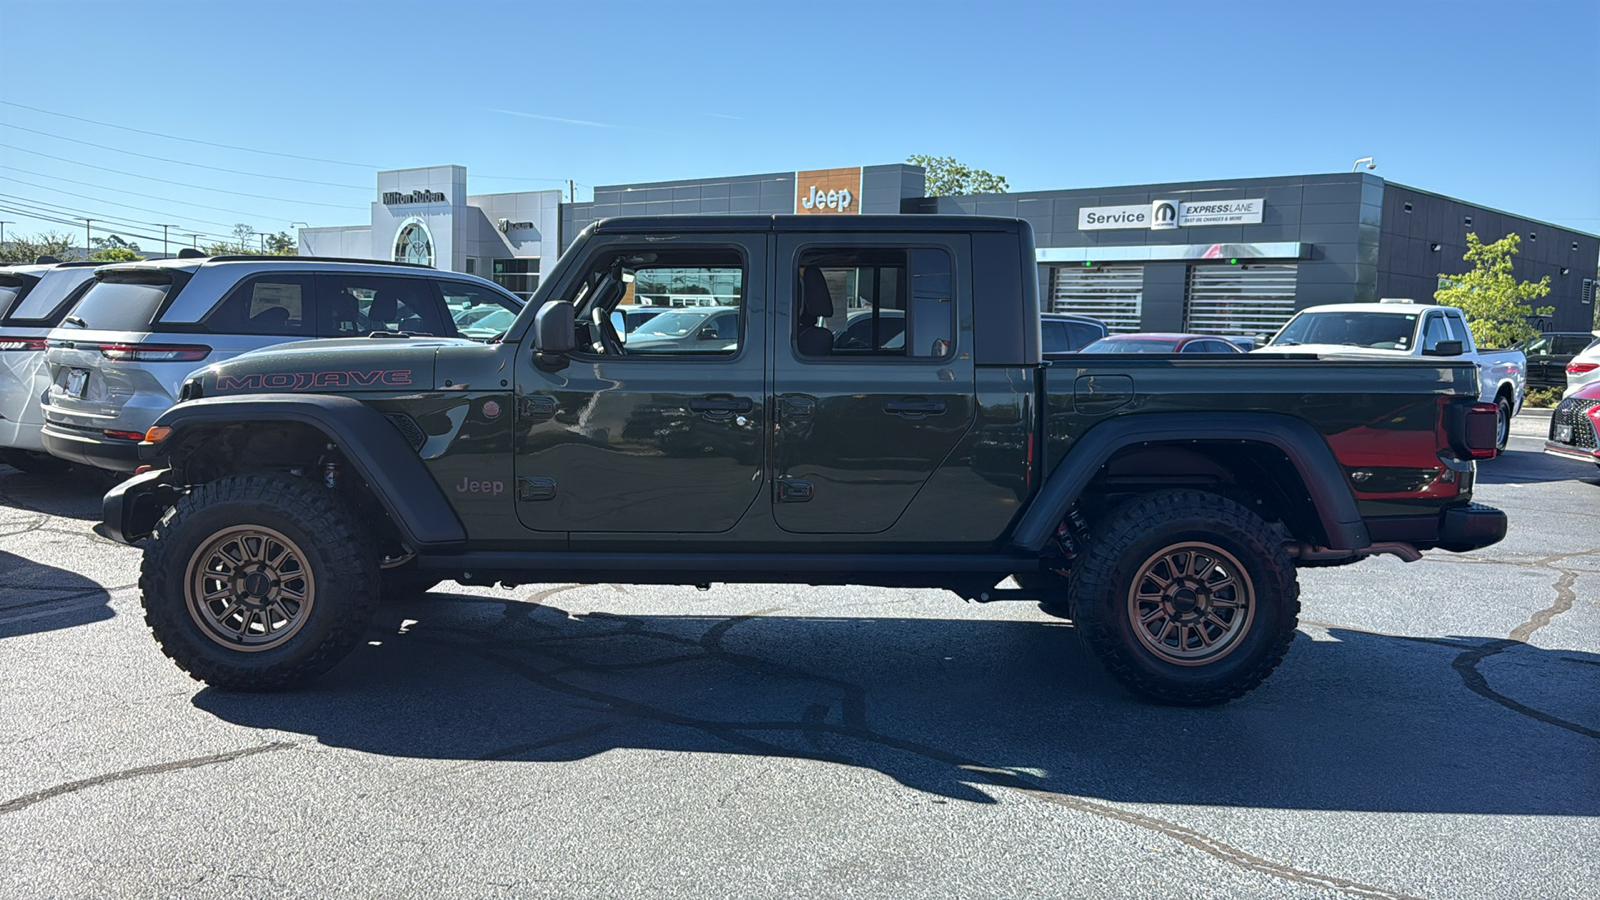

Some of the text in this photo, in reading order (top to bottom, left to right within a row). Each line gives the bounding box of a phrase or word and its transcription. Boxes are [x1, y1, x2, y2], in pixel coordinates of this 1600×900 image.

[383, 189, 445, 205] Milton Ruben
[802, 186, 851, 212] Jeep
[1086, 211, 1145, 224] Service
[215, 369, 412, 391] MOJAVE
[455, 477, 504, 496] Jeep
